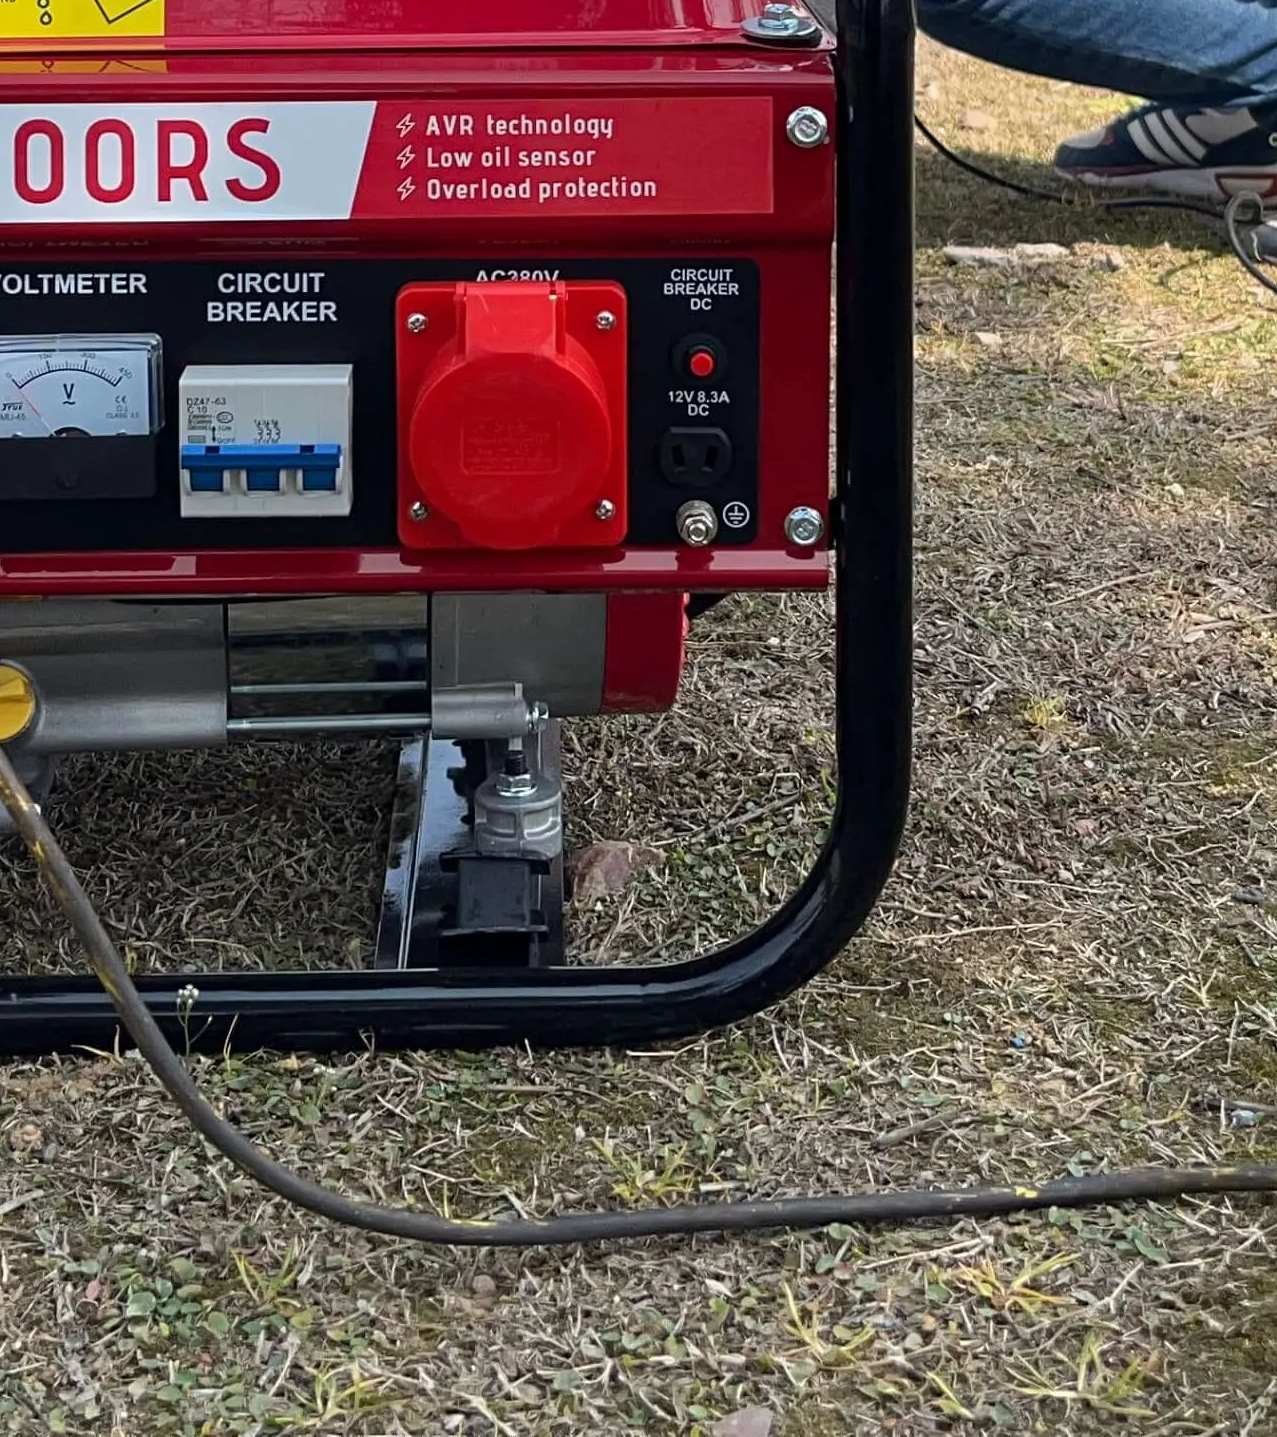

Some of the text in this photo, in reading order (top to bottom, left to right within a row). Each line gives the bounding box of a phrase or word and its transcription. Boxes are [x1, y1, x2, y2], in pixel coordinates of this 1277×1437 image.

[426, 114, 614, 139] AVR technology
[426, 146, 596, 168] Low oil sensor
[426, 176, 657, 203] Overload protection
[217, 272, 326, 294] CIRCUIT
[670, 268, 734, 282] CIRCUIT
[663, 282, 740, 296] BREAKER
[206, 301, 338, 322] BREAKER
[690, 297, 713, 311] DC
[668, 391, 730, 403] 12V 8.3A
[687, 404, 710, 416] DC
